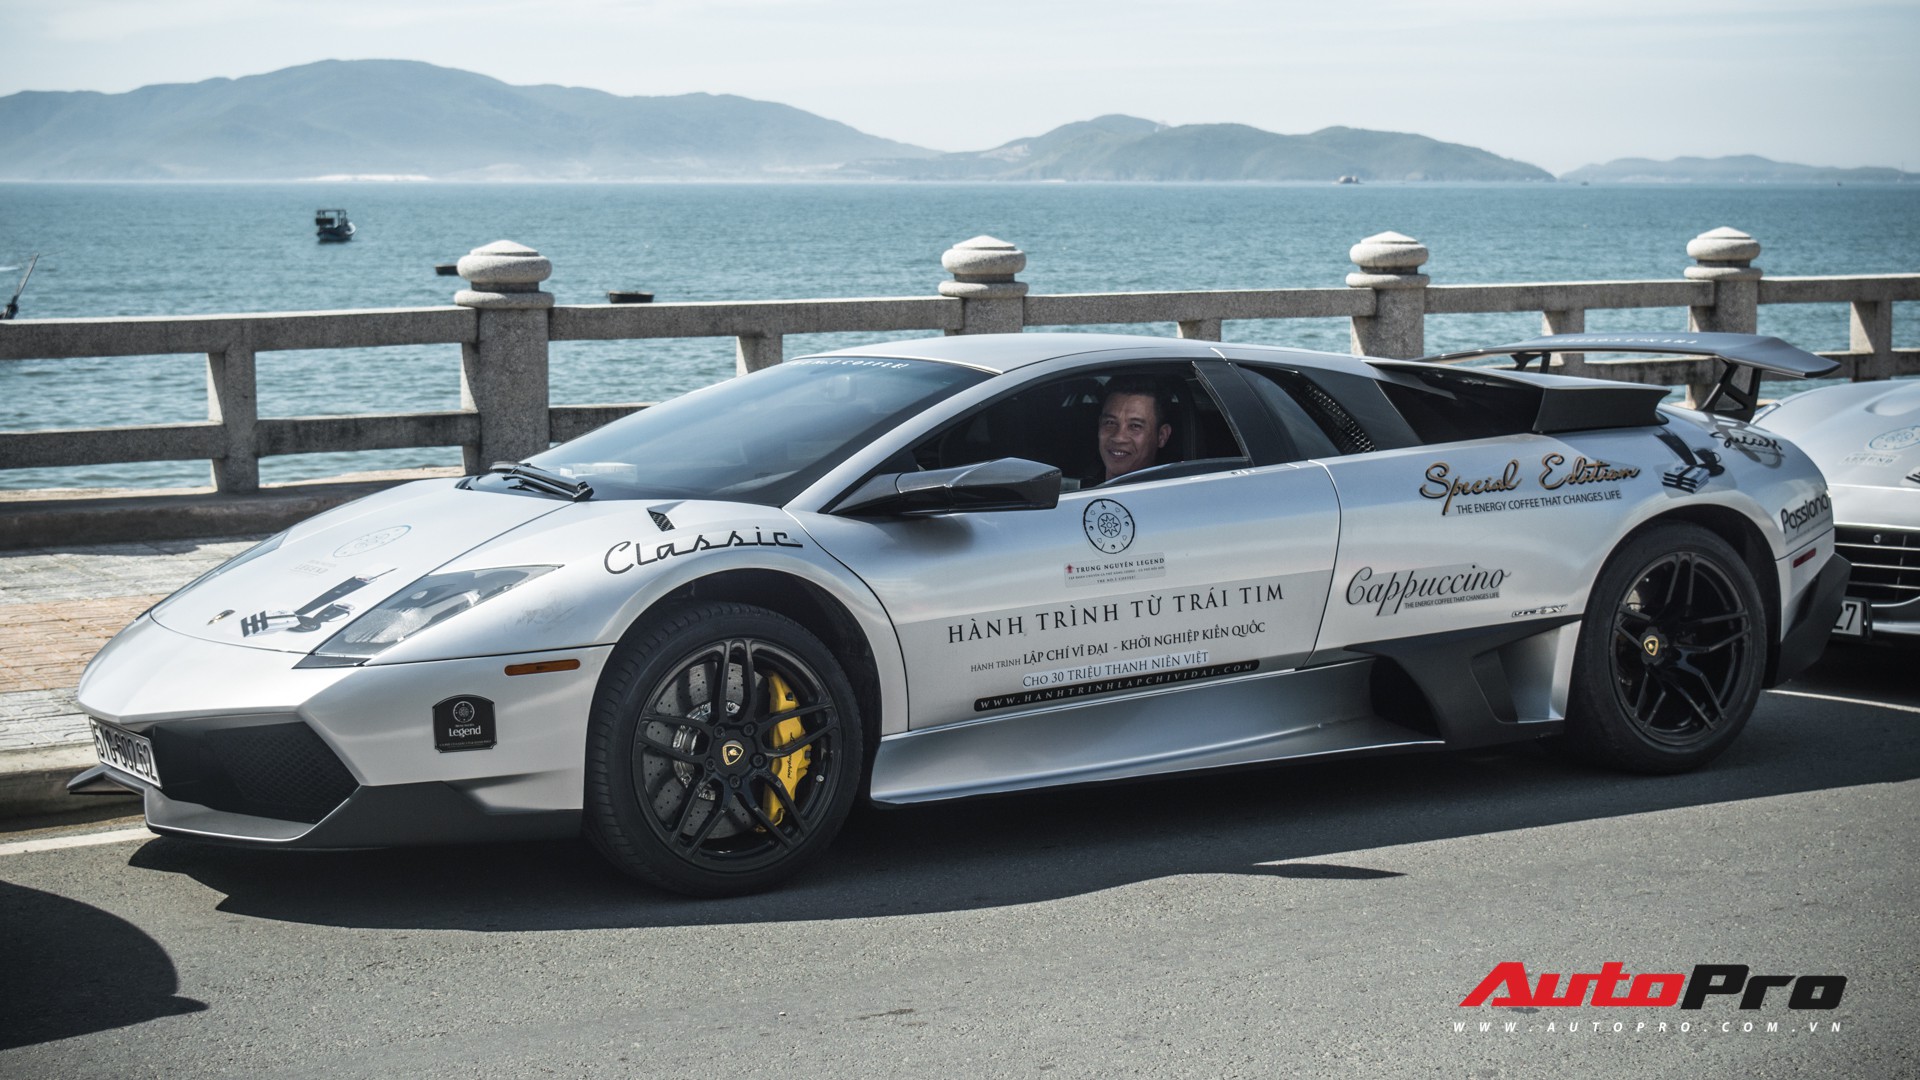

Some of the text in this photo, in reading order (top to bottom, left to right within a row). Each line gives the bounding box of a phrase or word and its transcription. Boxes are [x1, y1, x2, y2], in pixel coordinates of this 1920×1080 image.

[1419, 452, 1641, 516] Special Edition
[1456, 490, 1622, 515] THE ENERGY COFFEE THAT CHANGES LIFE
[604, 526, 803, 574] Classic
[1076, 564, 1101, 573] TRUNG
[1136, 557, 1165, 567] LEGEND
[948, 583, 1284, 643] HÀNH TRÌNH TỪ TRÁI TIM
[1346, 565, 1511, 616] Cappuccino
[970, 661, 994, 672] HÀNH
[995, 658, 1021, 668] TRÌNH
[1023, 651, 1044, 666] LẬP
[1046, 646, 1069, 661] CHÍ
[1087, 643, 1108, 656] ĐẠI
[1121, 635, 1151, 651] KHỞI
[1154, 629, 1199, 646] NGHIỆP
[1202, 624, 1229, 640] KIẾN
[1231, 620, 1266, 637] QUỐC
[1023, 651, 1208, 687] CHO 30 TRIỆU THANH NIÊN VIỆT
[448, 725, 482, 737] Legend
